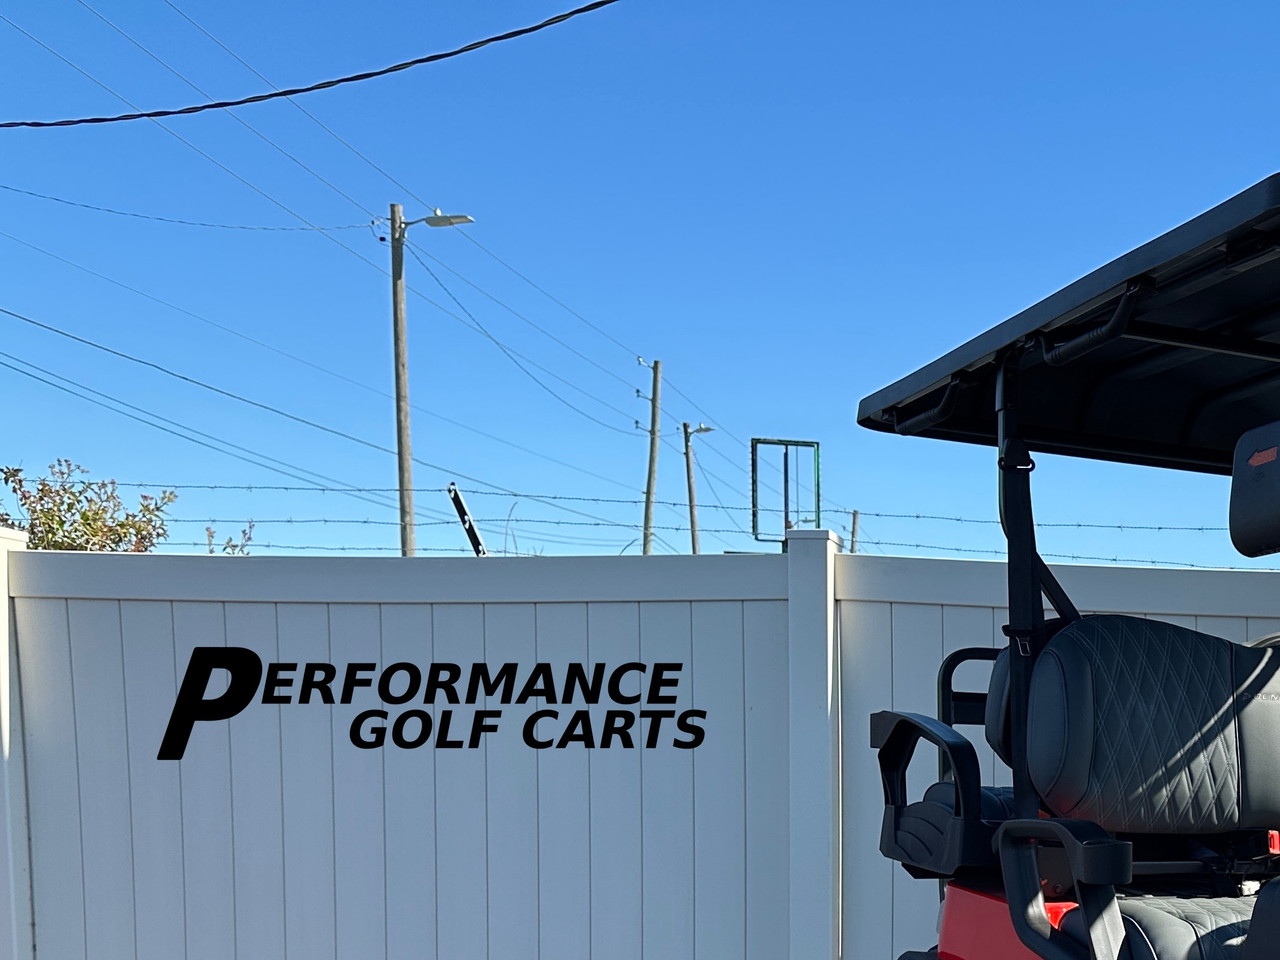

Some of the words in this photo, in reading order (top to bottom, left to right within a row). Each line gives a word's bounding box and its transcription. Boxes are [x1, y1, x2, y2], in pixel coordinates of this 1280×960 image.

[157, 646, 683, 760] PERFORMANCE
[349, 709, 502, 750] GOLF
[522, 709, 707, 750] CARTS
